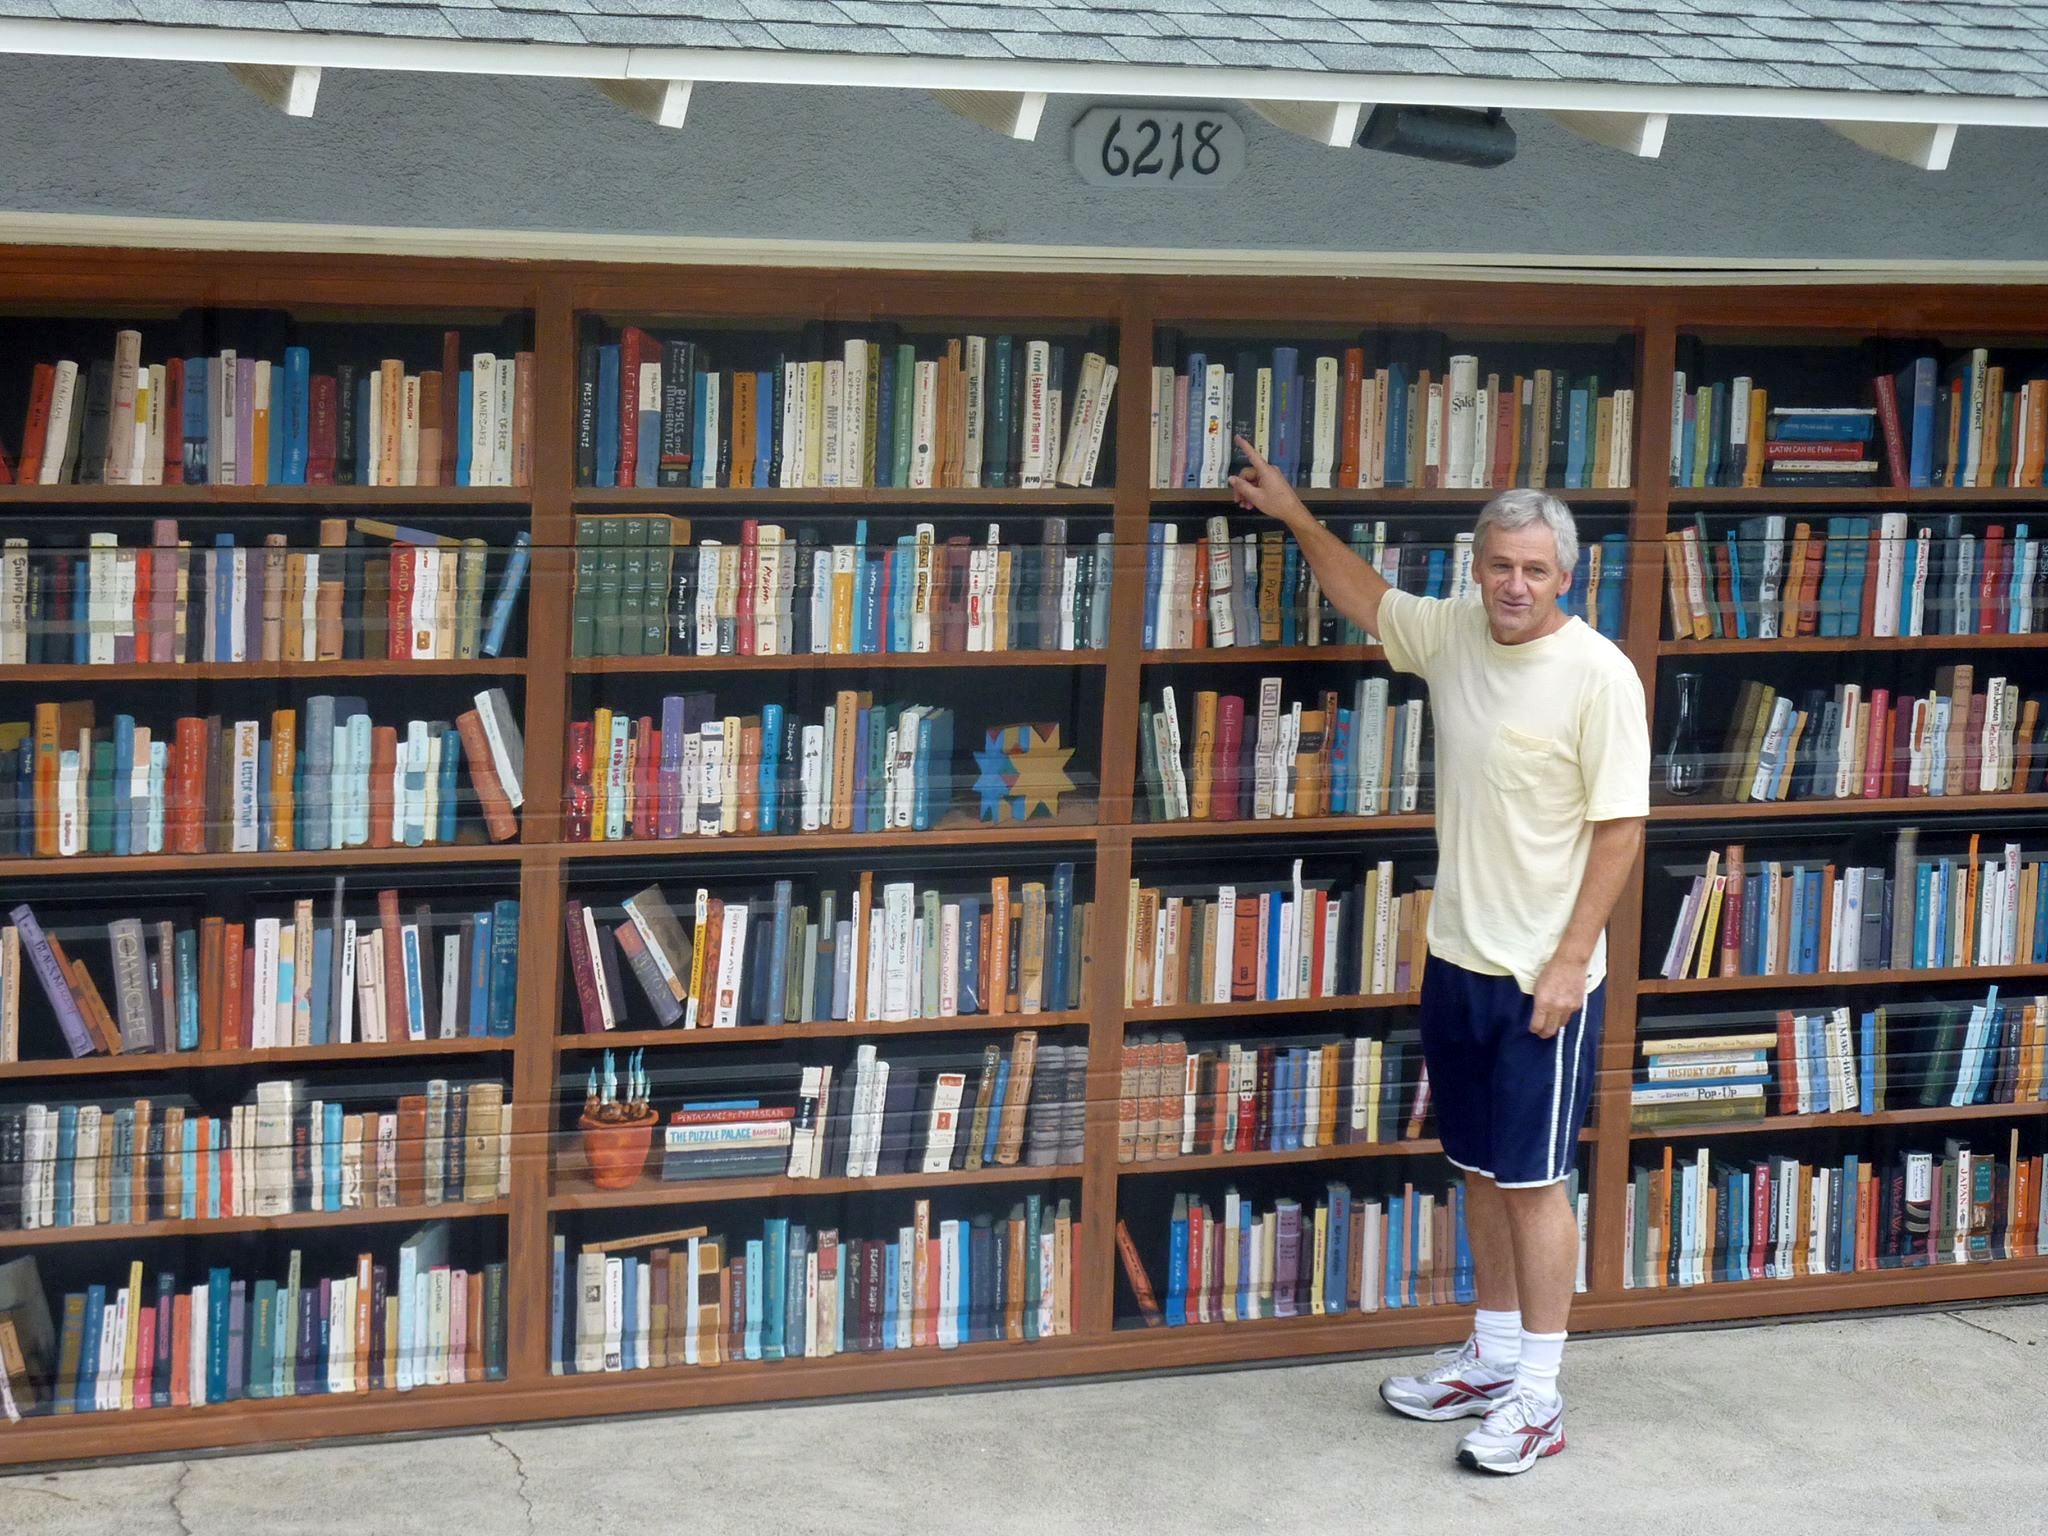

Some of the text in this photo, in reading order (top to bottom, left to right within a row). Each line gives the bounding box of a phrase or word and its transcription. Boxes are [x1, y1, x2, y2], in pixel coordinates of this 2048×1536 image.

[1102, 115, 1224, 181] 6218
[1974, 360, 1986, 389] Simple
[664, 384, 678, 455] MATHEMATICS
[673, 388, 687, 455] PHYSICS and
[1973, 401, 1983, 430] Direct
[1769, 445, 1792, 454] LATIN
[1793, 445, 1806, 453] CAN
[1817, 445, 1833, 453] FUN
[11, 557, 26, 592] Simple
[394, 553, 409, 654] WORLD ALMANAC
[1993, 681, 2002, 696] Paul
[1794, 887, 1803, 916] ETHICS
[115, 928, 147, 1041] TOM WOLFE
[1667, 1065, 1738, 1078] HISTORY OF ART
[670, 1131, 688, 1145] THE
[688, 1129, 721, 1144] PUZZLE
[721, 1127, 753, 1142] PALACE
[1960, 1168, 1970, 1205] JAPAN
[1889, 1175, 1905, 1255] Wicked Words
